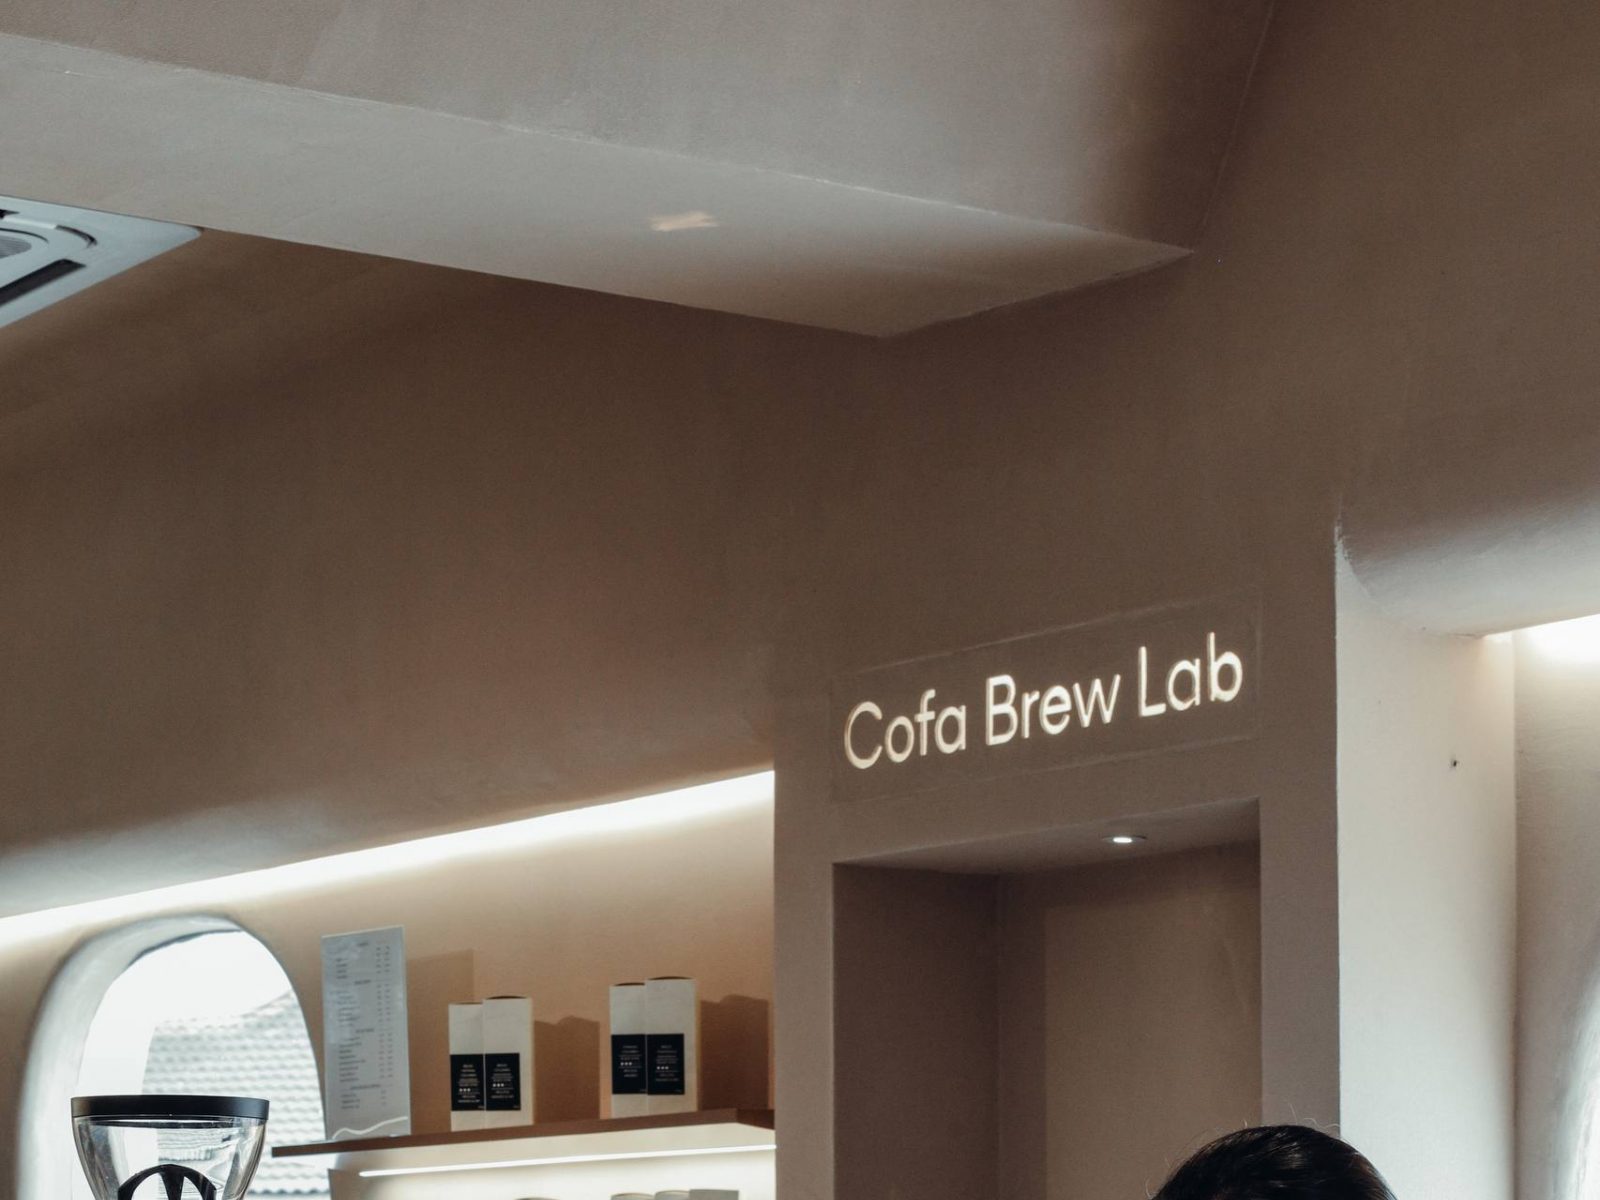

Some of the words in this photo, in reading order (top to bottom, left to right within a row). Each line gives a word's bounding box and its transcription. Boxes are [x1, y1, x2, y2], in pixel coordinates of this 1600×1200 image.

[844, 688, 967, 769] Cofa
[985, 674, 1121, 745] Brew
[1138, 631, 1243, 716] Lab
